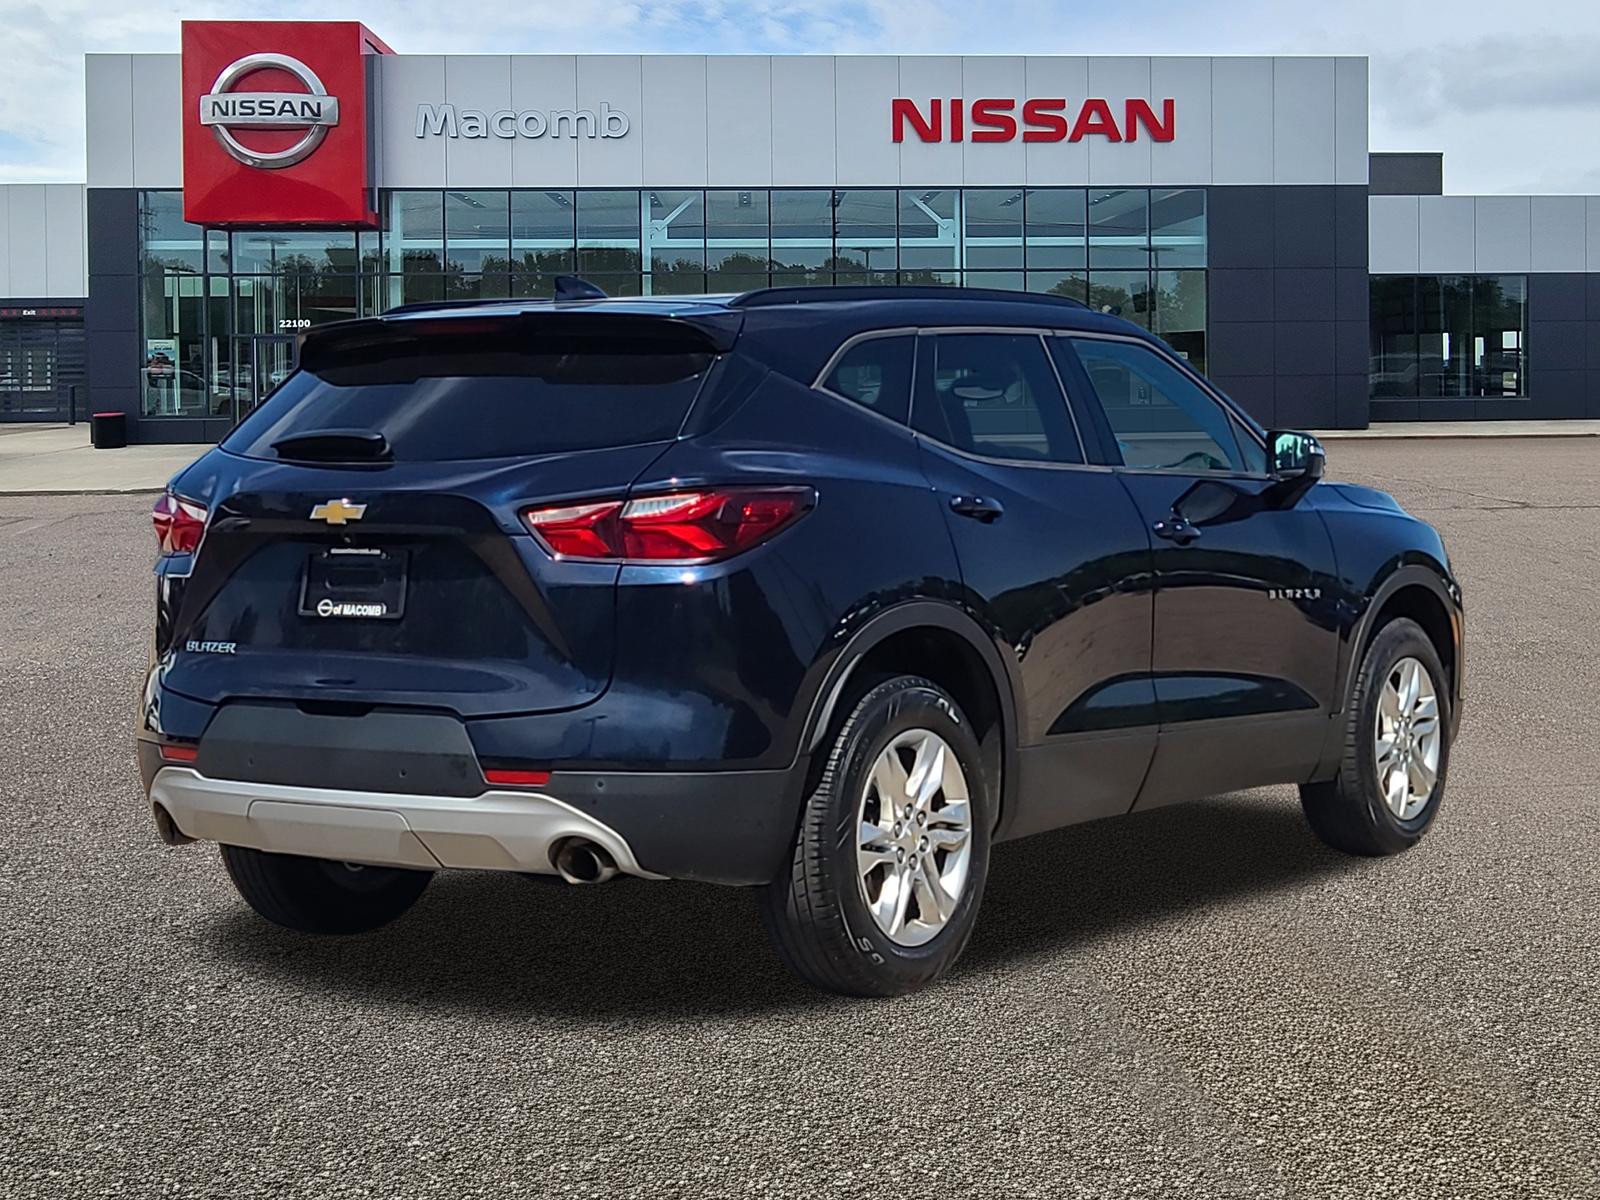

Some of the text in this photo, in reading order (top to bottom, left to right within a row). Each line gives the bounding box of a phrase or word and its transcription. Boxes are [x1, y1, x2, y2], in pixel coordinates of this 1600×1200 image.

[211, 100, 322, 117] NISSAN
[415, 101, 630, 139] Macomb
[892, 98, 1175, 143] NISSAN
[279, 319, 311, 328] 22100
[342, 604, 382, 617] MACOMB
[186, 640, 236, 654] BLAZER
